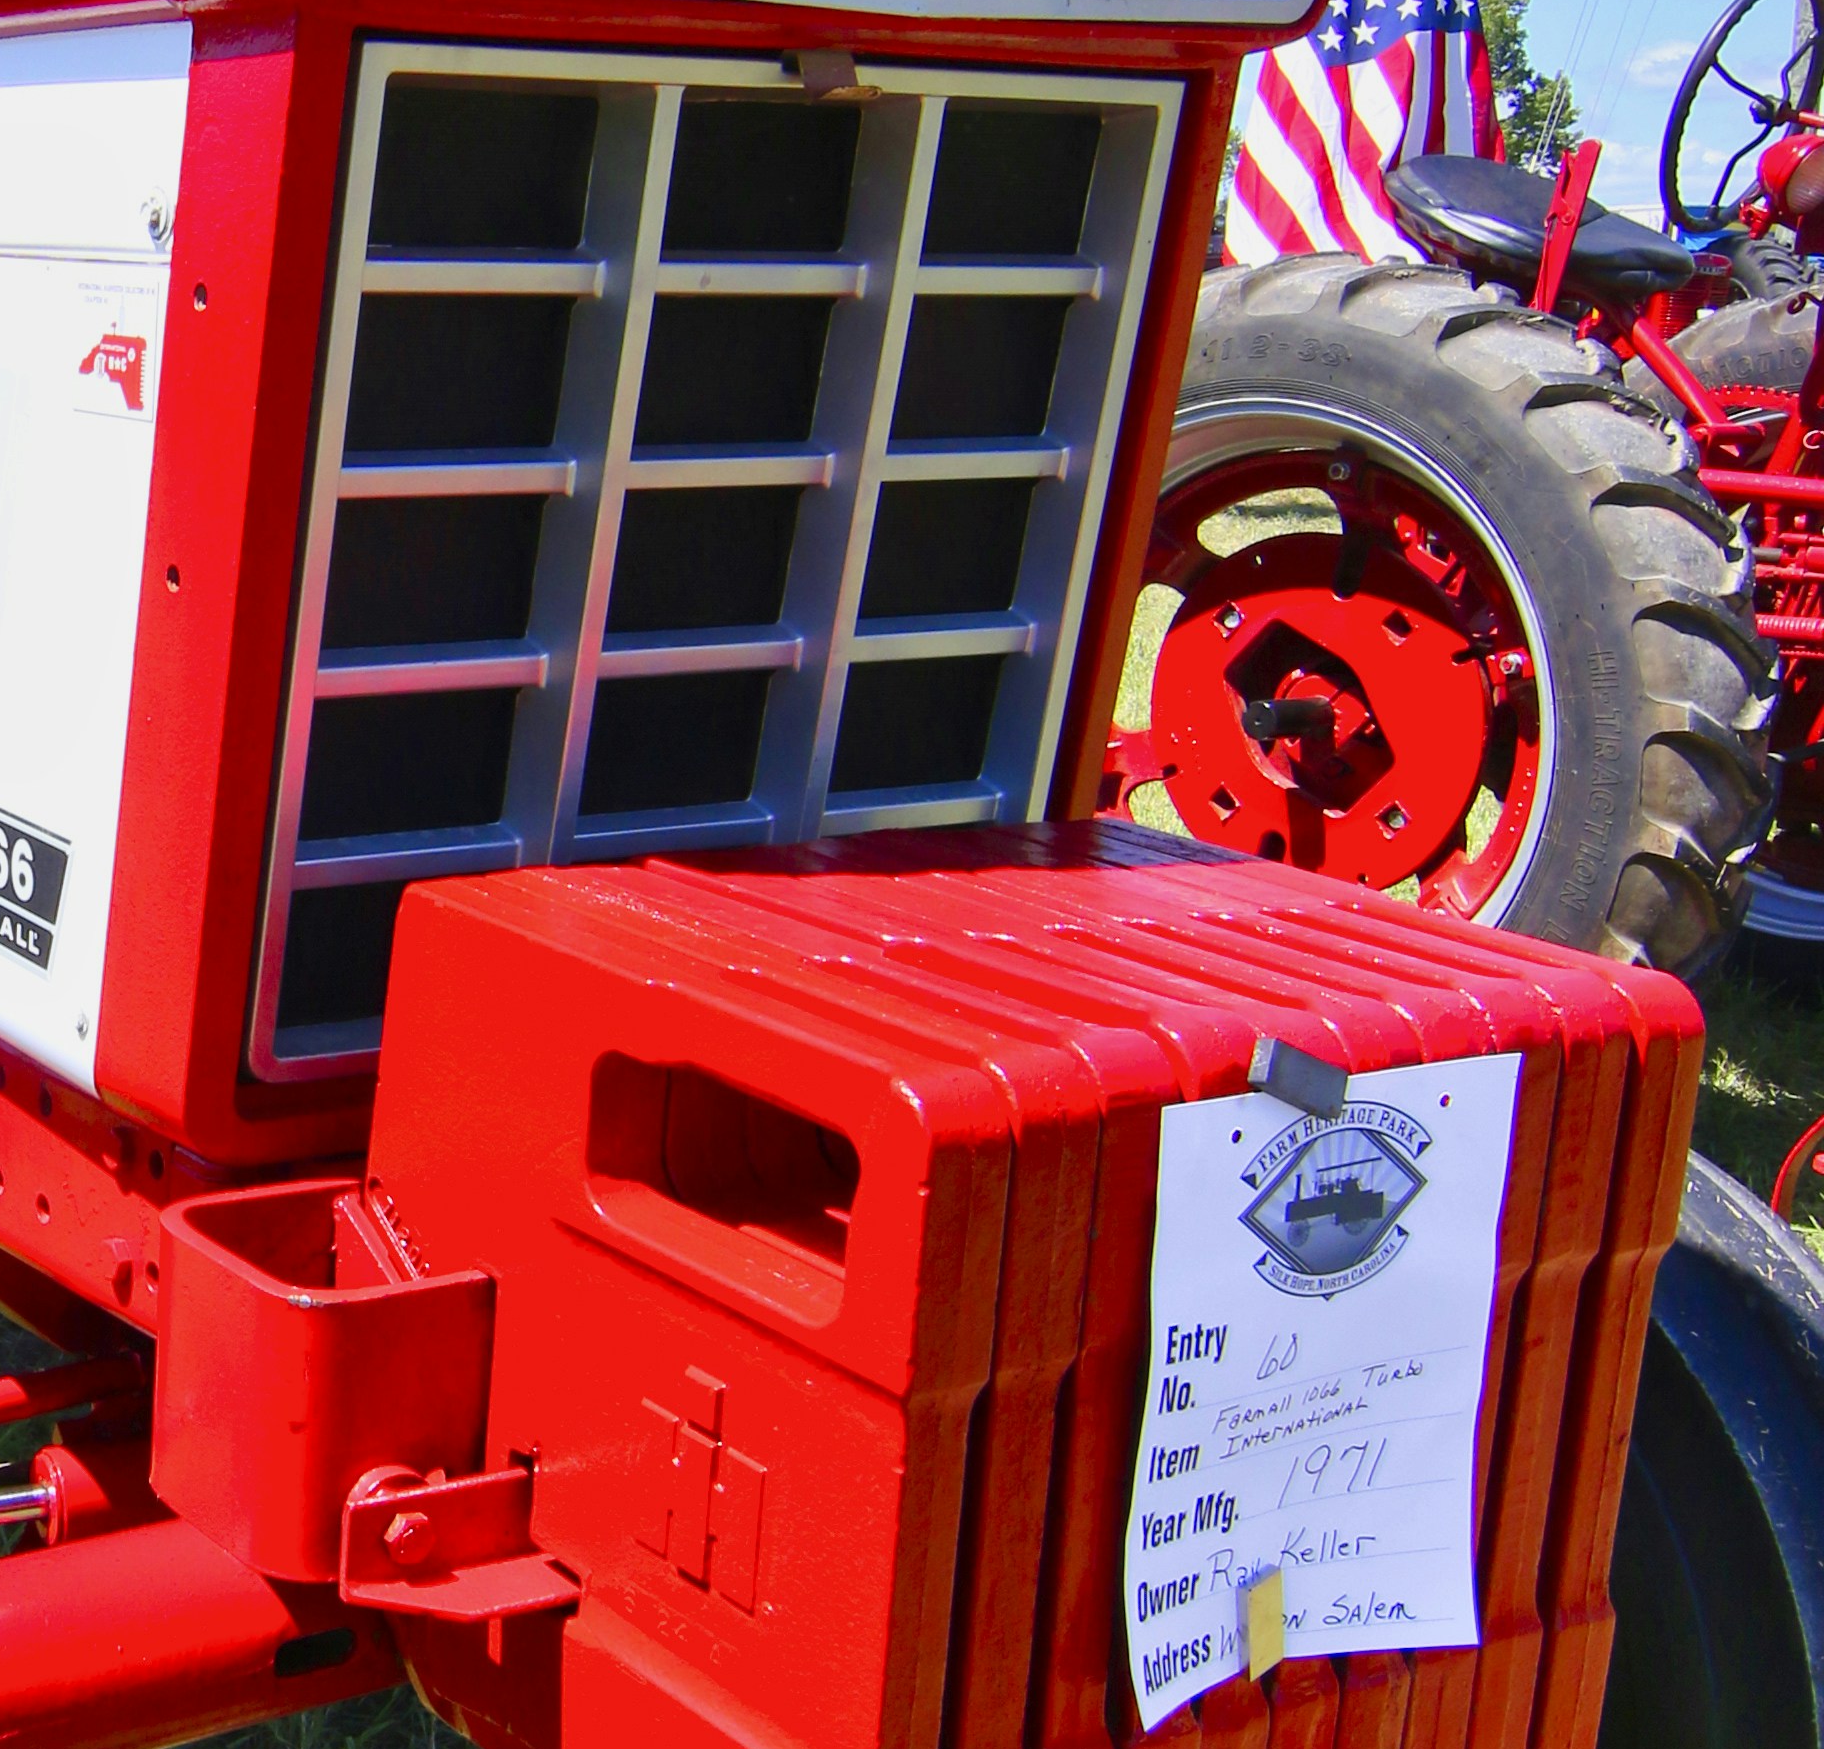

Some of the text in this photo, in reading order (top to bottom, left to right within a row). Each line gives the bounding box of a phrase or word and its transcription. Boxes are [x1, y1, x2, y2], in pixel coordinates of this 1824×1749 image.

[1257, 1131, 1299, 1172] FARM
[1378, 1109, 1418, 1144] PARK
[1268, 1264, 1291, 1284] SILK
[1316, 1275, 1349, 1291] NORTH
[1351, 1242, 1396, 1281] CAROLINA
[1165, 1323, 1228, 1365] Entry
[1158, 1375, 1196, 1415] No.
[1302, 1378, 1341, 1406] 1066
[1148, 1444, 1200, 1484] Item
[1277, 1438, 1387, 1509] 1971
[1141, 1489, 1240, 1551] Year Mfg.
[1278, 1527, 1376, 1568] Keller
[1137, 1571, 1201, 1623] Owner
[1142, 1633, 1212, 1697] Address
